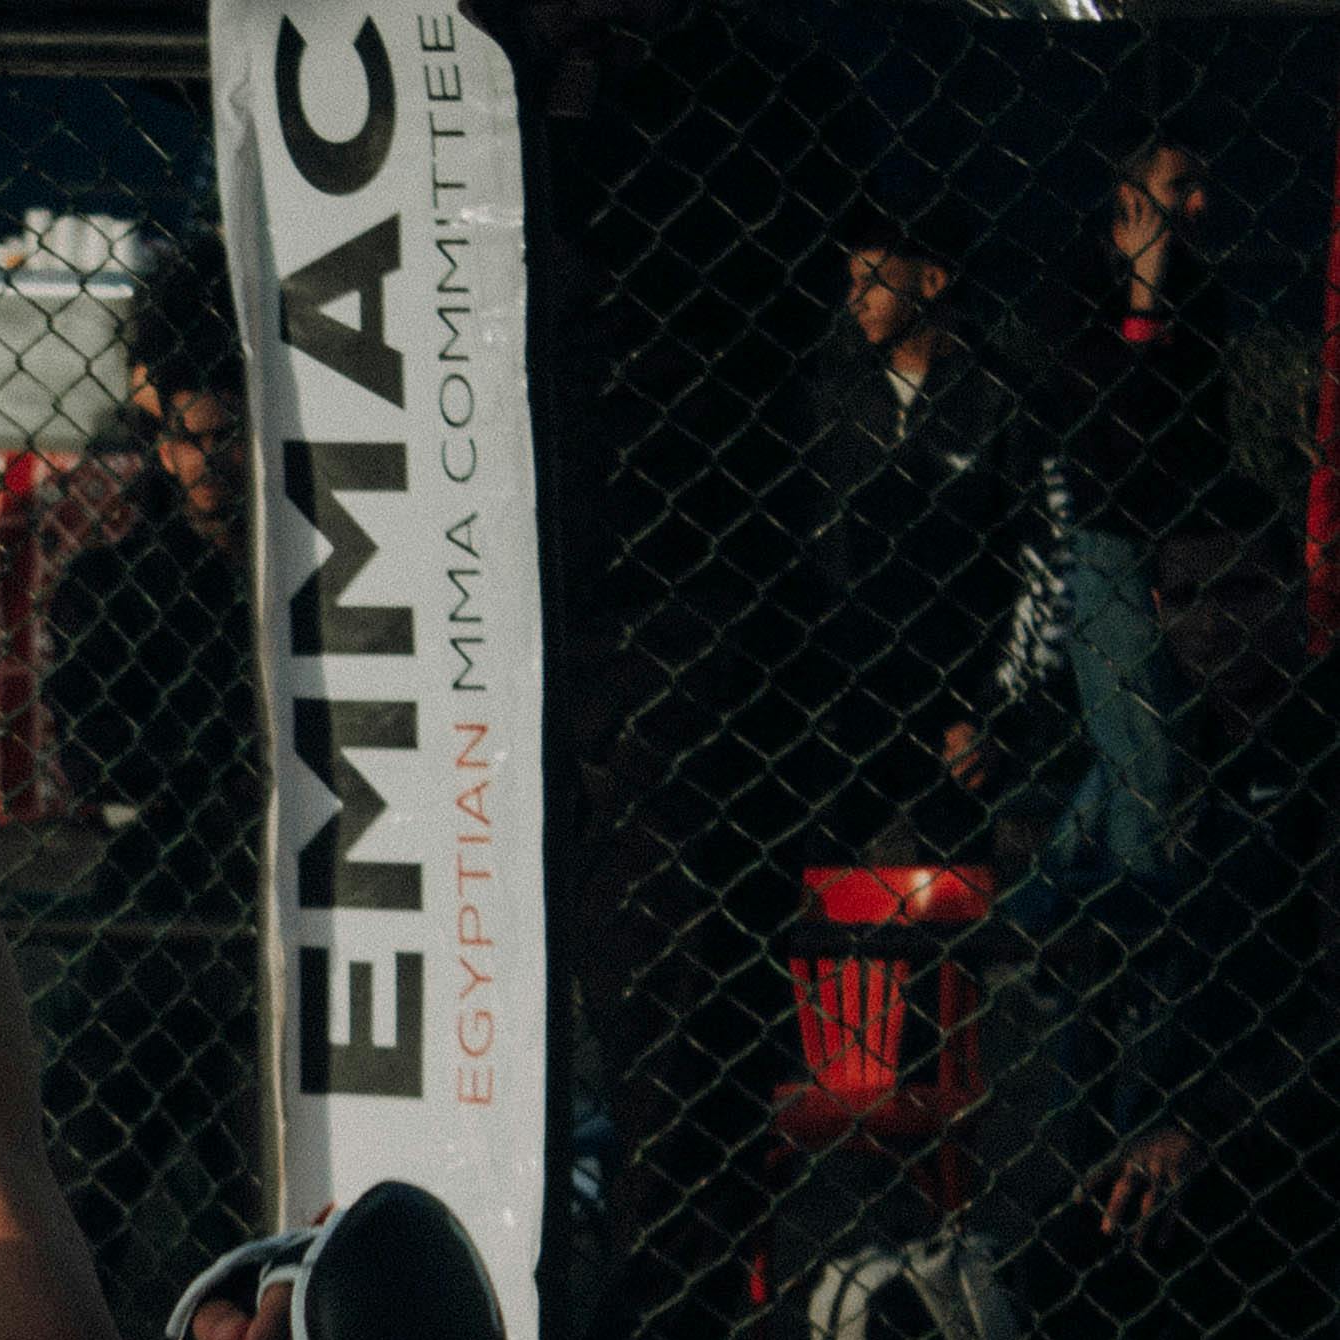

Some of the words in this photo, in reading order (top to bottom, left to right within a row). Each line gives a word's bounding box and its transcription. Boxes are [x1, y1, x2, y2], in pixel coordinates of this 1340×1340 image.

[274, 13, 425, 1099] EMMAC
[445, 511, 488, 692] MMA
[455, 721, 495, 1107] EGYPTIAN
